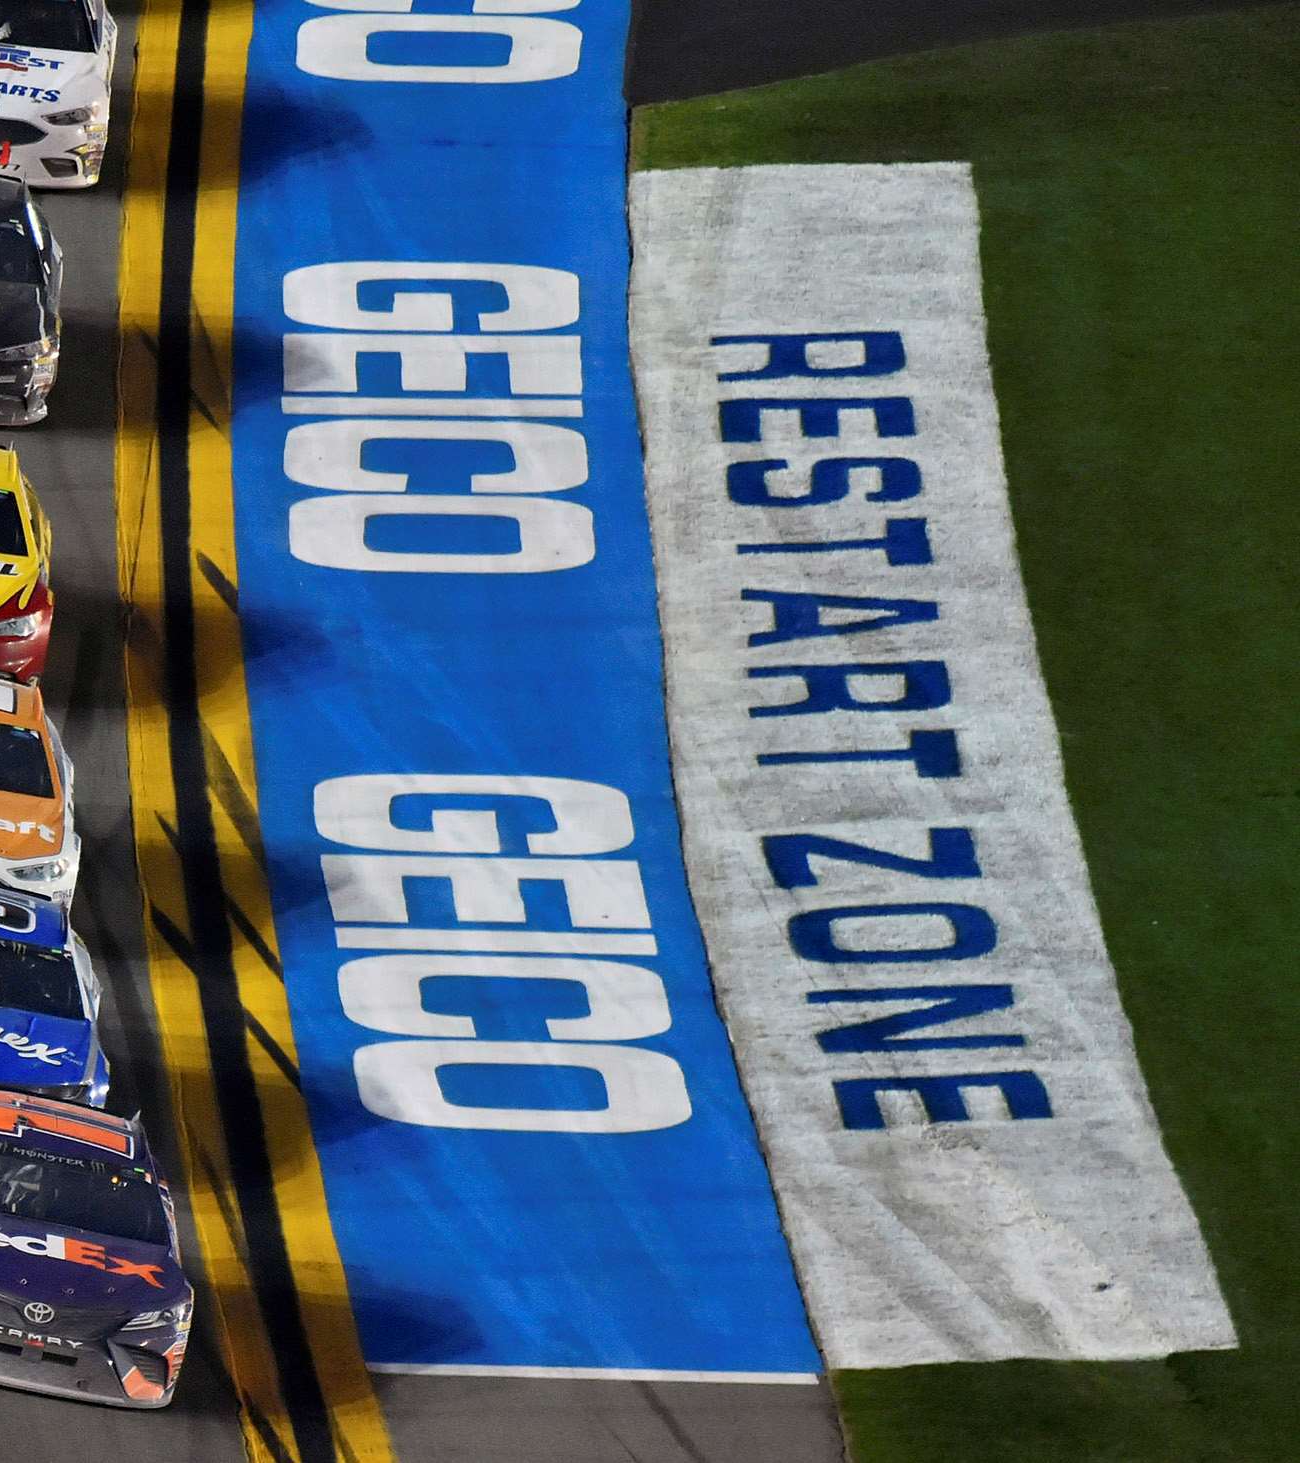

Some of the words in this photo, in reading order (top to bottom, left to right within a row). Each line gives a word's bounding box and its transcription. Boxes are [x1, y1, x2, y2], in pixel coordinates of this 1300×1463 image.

[281, 261, 596, 573] GEICO
[710, 330, 961, 778] RESTART
[313, 773, 693, 1133] GEICO
[762, 826, 1053, 1131] ZONE
[12, 1146, 85, 1168] MONSTER
